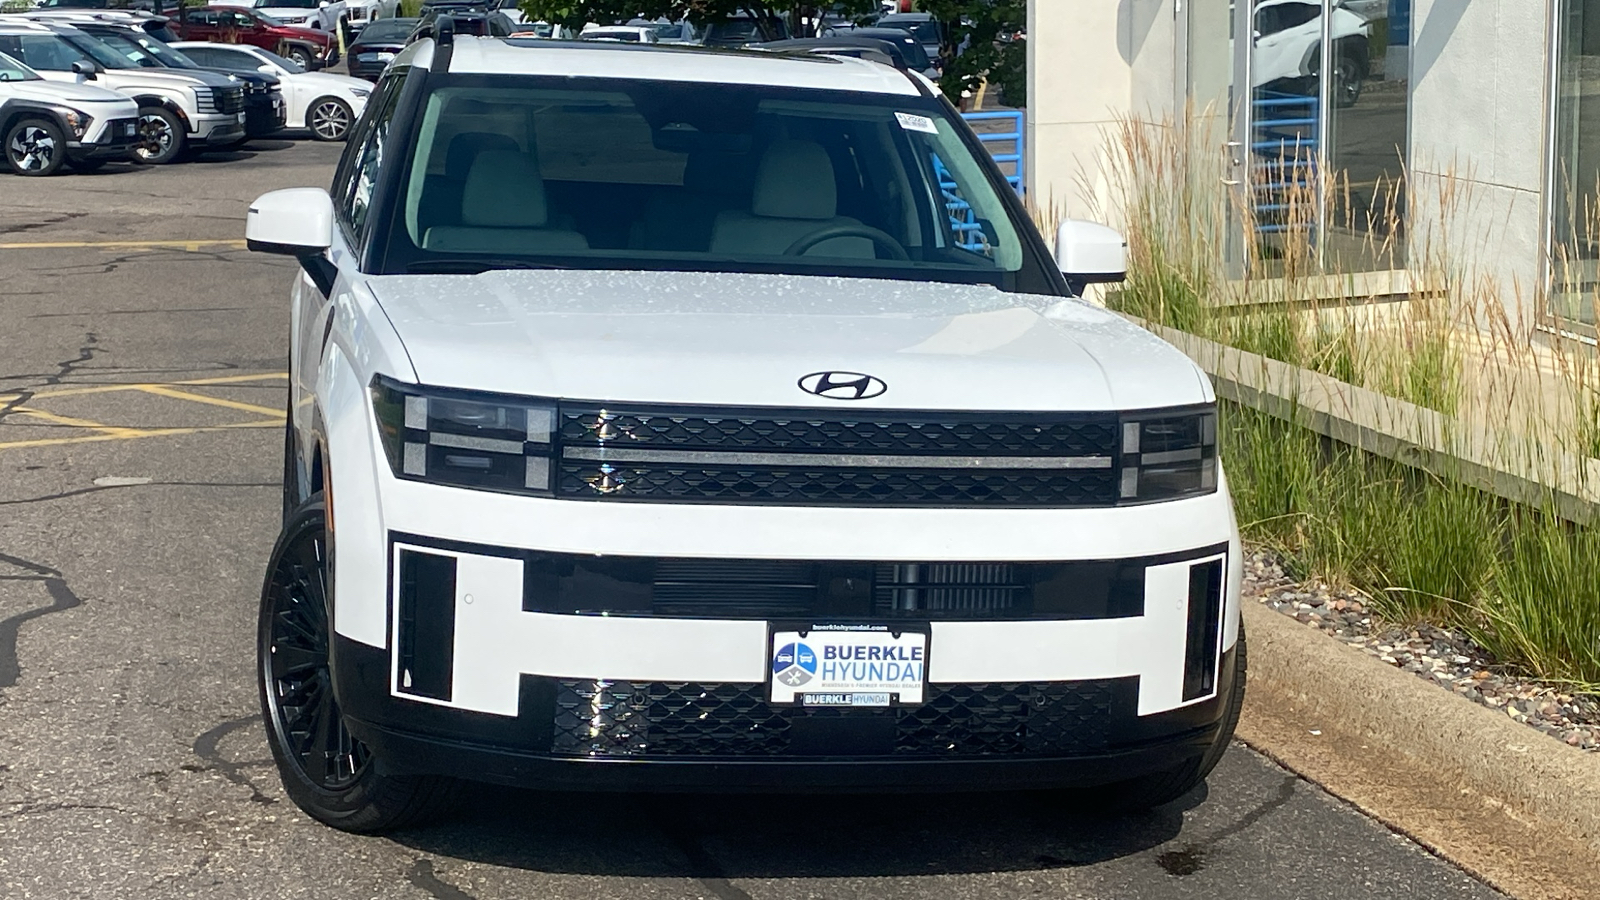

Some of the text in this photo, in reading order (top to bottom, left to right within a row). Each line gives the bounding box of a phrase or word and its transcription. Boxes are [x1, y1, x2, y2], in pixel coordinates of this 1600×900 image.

[812, 624, 888, 632] buerklehyundai.com
[824, 645, 922, 661] BUERKLE
[822, 662, 922, 681] HYUNDAI
[804, 694, 888, 704] BUERKLE HYUNDAI
